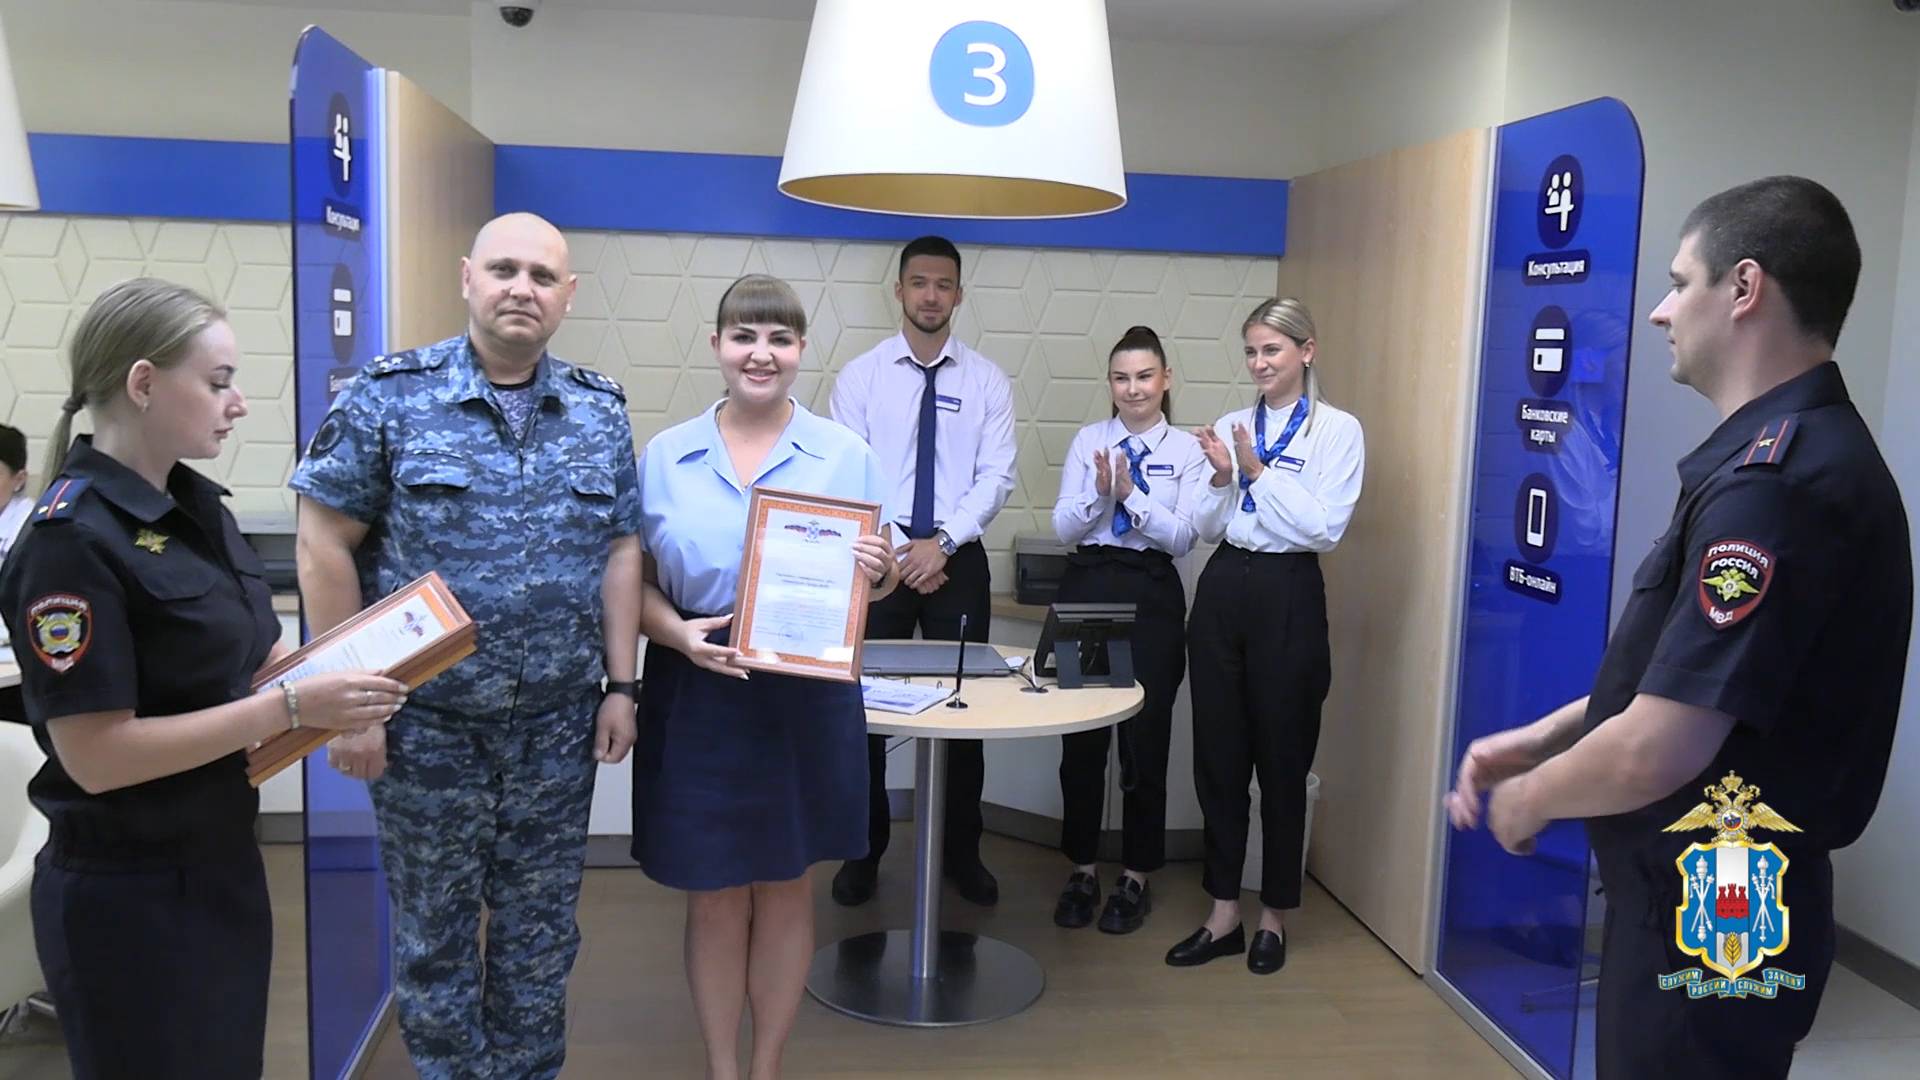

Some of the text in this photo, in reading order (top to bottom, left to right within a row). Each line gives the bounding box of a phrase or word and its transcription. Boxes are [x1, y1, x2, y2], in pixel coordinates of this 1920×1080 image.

[964, 42, 1007, 106] 3
[1528, 260, 1585, 279] Консультация
[1522, 404, 1568, 424] Банковские
[1530, 429, 1556, 445] карты
[1708, 544, 1768, 568] ПОЛИЦИЯ
[1711, 558, 1758, 579] РОССИЯ
[1510, 566, 1556, 594] ВТБ-онлайн
[1709, 607, 1733, 624] МВД
